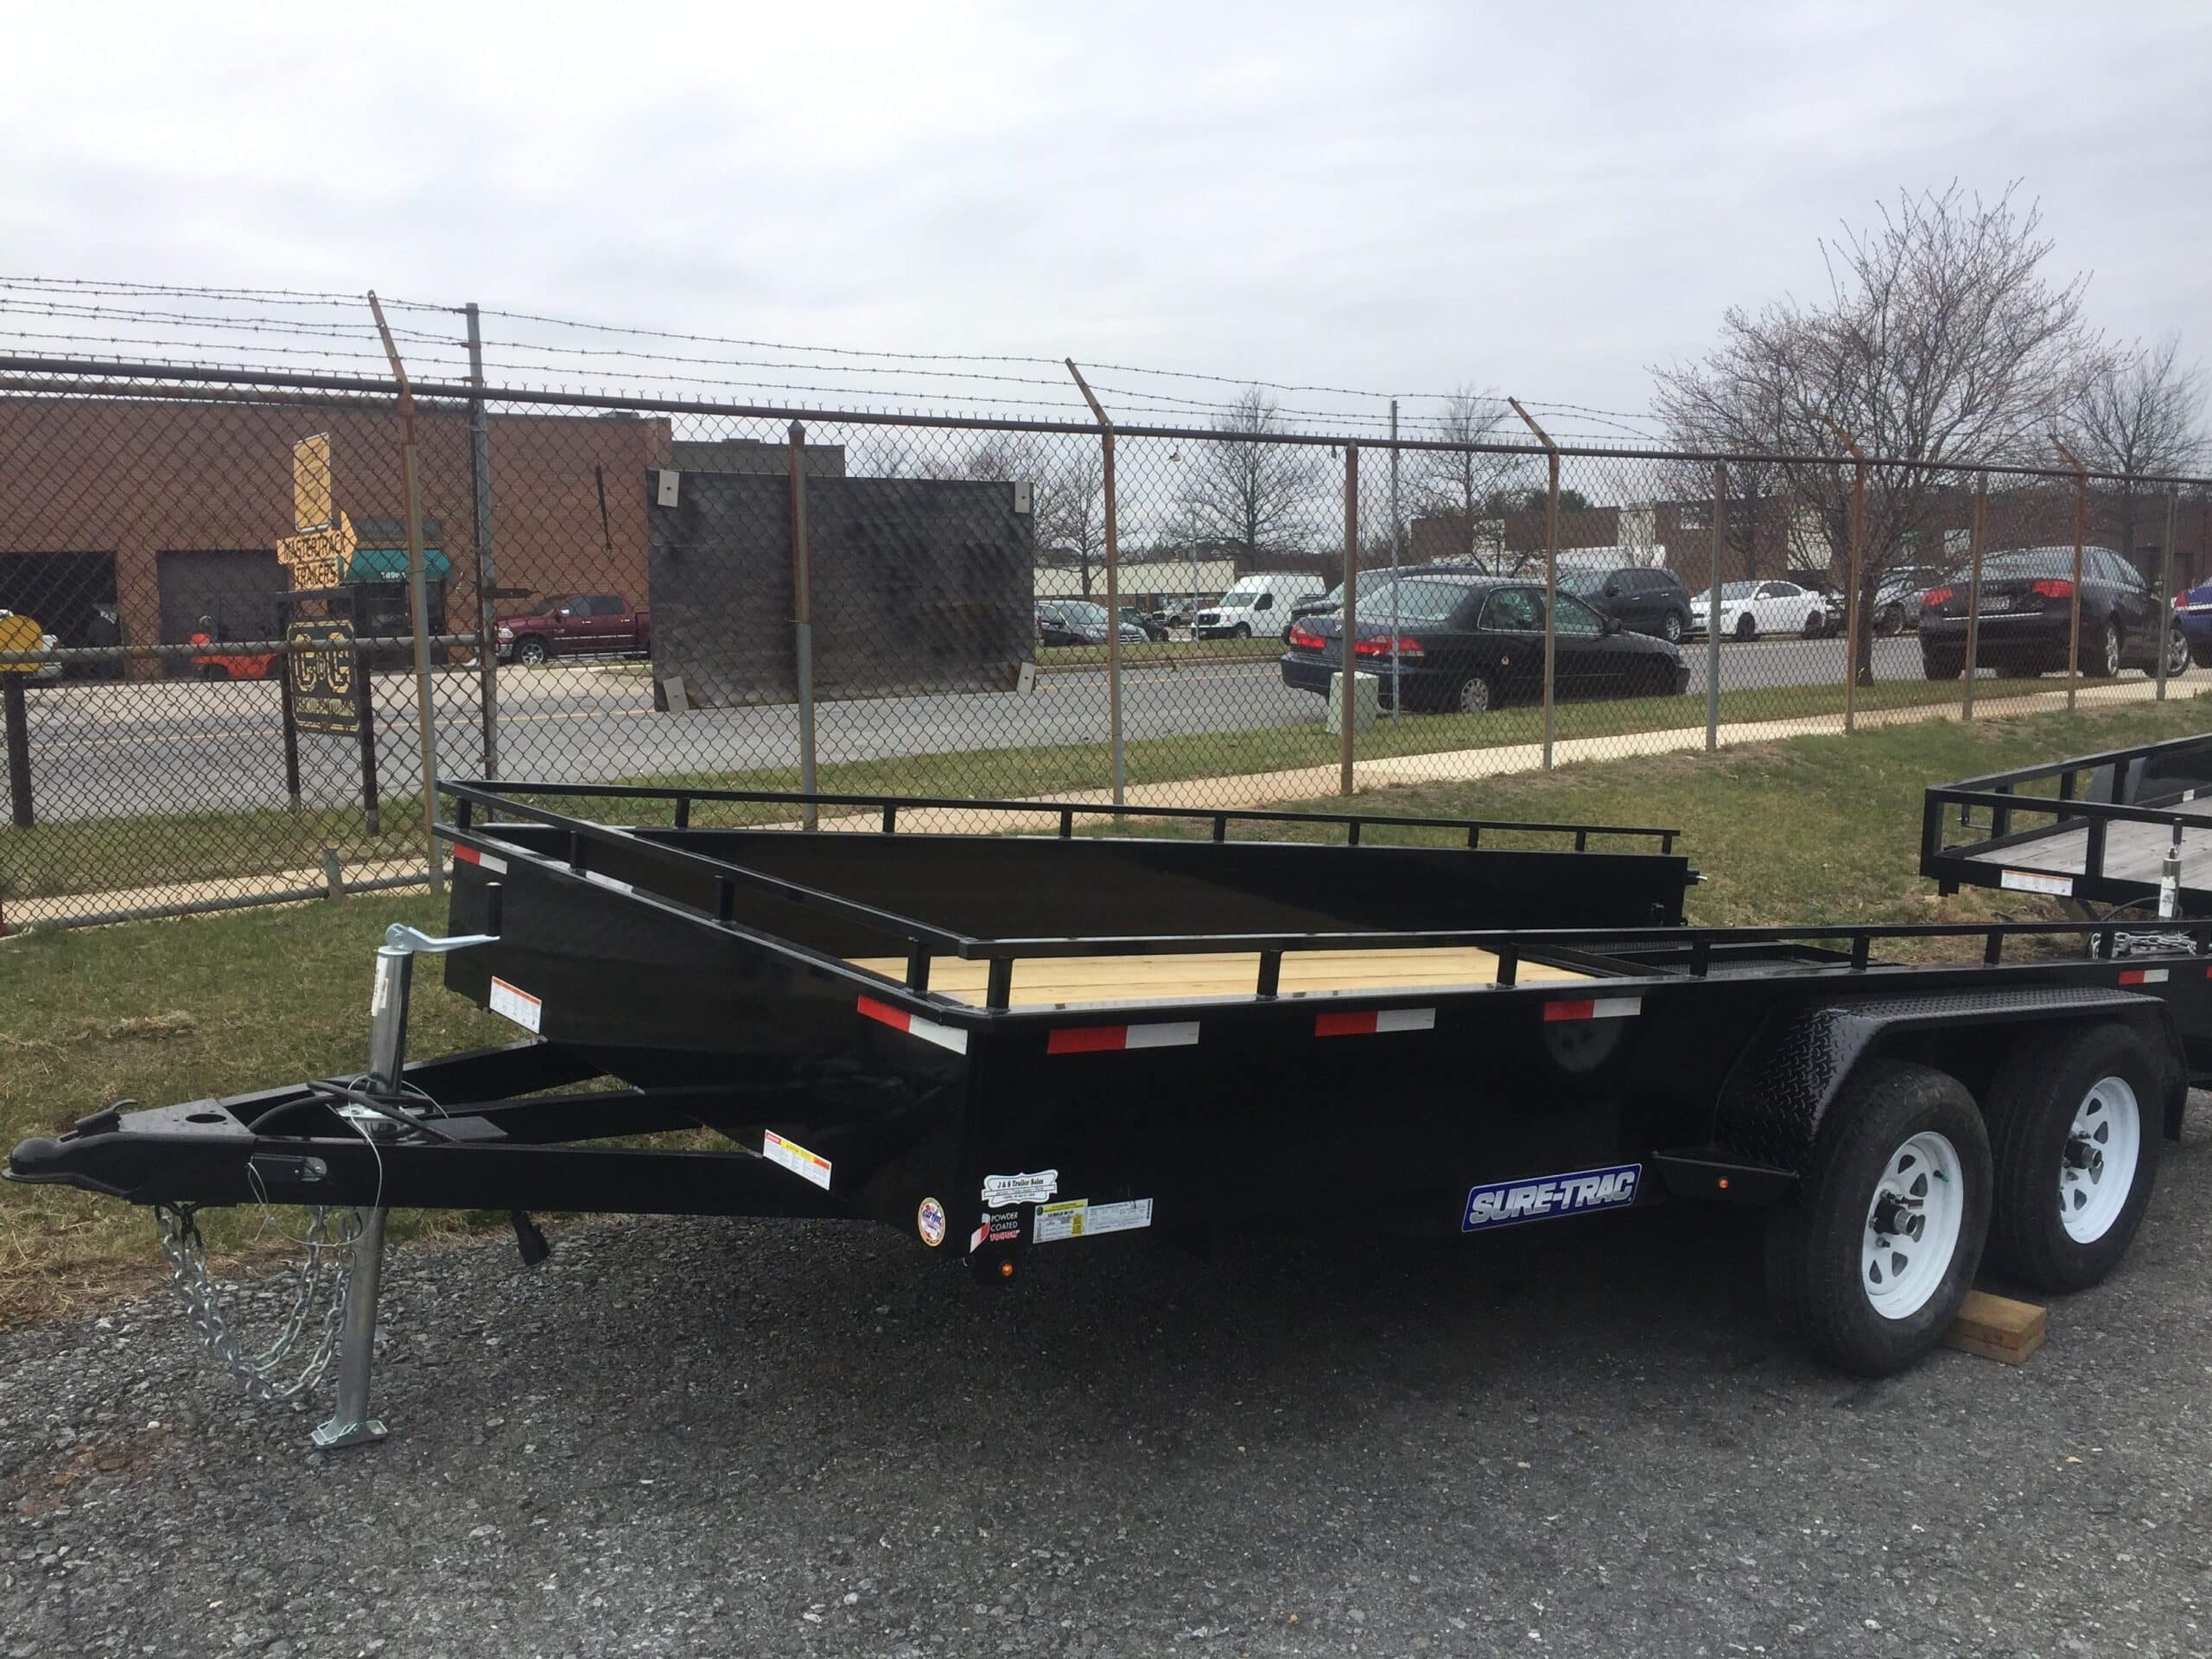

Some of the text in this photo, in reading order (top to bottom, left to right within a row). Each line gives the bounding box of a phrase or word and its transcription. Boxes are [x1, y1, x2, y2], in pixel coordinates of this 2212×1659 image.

[1013, 1179, 1030, 1187] Trailer
[1469, 1171, 1636, 1224] SURE-TRAC
[991, 1211, 1019, 1223] POWDER
[990, 1221, 1018, 1232] COATED
